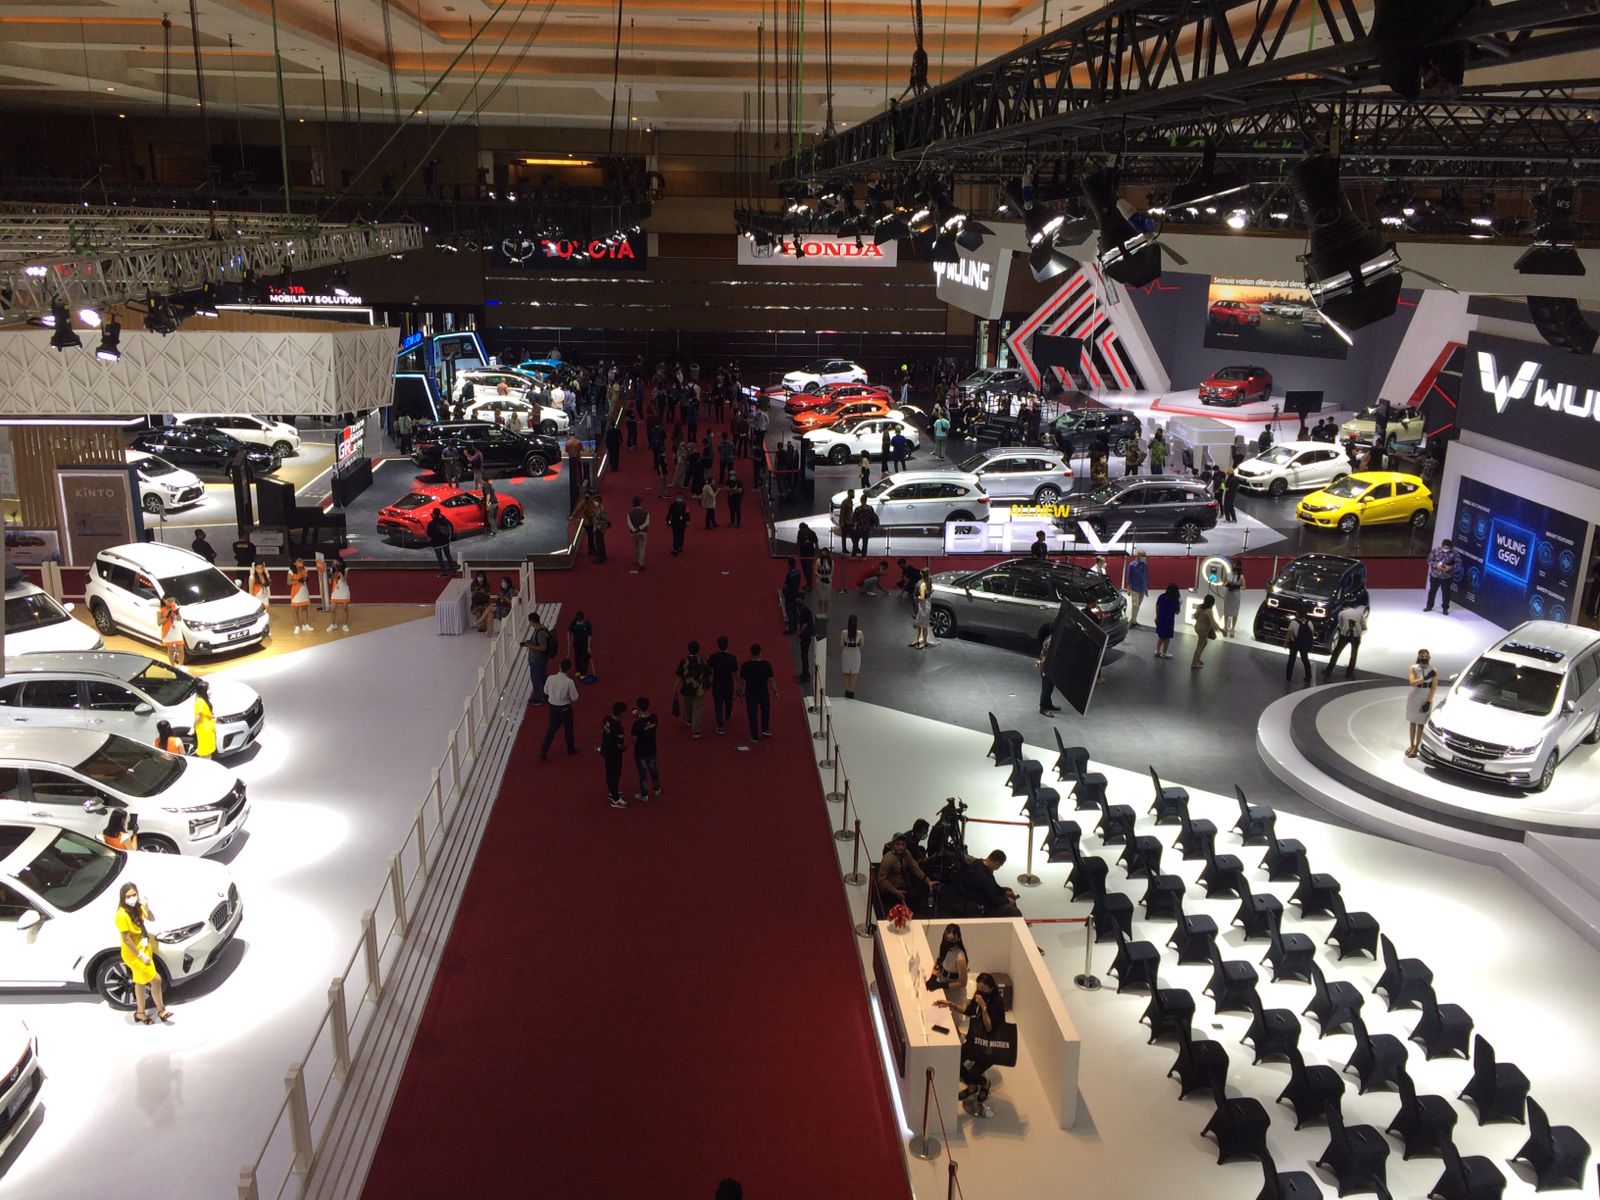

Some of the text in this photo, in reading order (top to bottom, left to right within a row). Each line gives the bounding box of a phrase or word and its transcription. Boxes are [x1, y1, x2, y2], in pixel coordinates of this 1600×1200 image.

[541, 239, 635, 259] TOOTA
[782, 241, 884, 257] HONDA
[1213, 276, 1235, 285] Semua
[269, 294, 362, 305] MOBILITY SOLUTION
[1496, 533, 1526, 555] WULING
[1498, 548, 1521, 567] GSEV
[974, 1037, 1010, 1049] STEVE MADDEN
